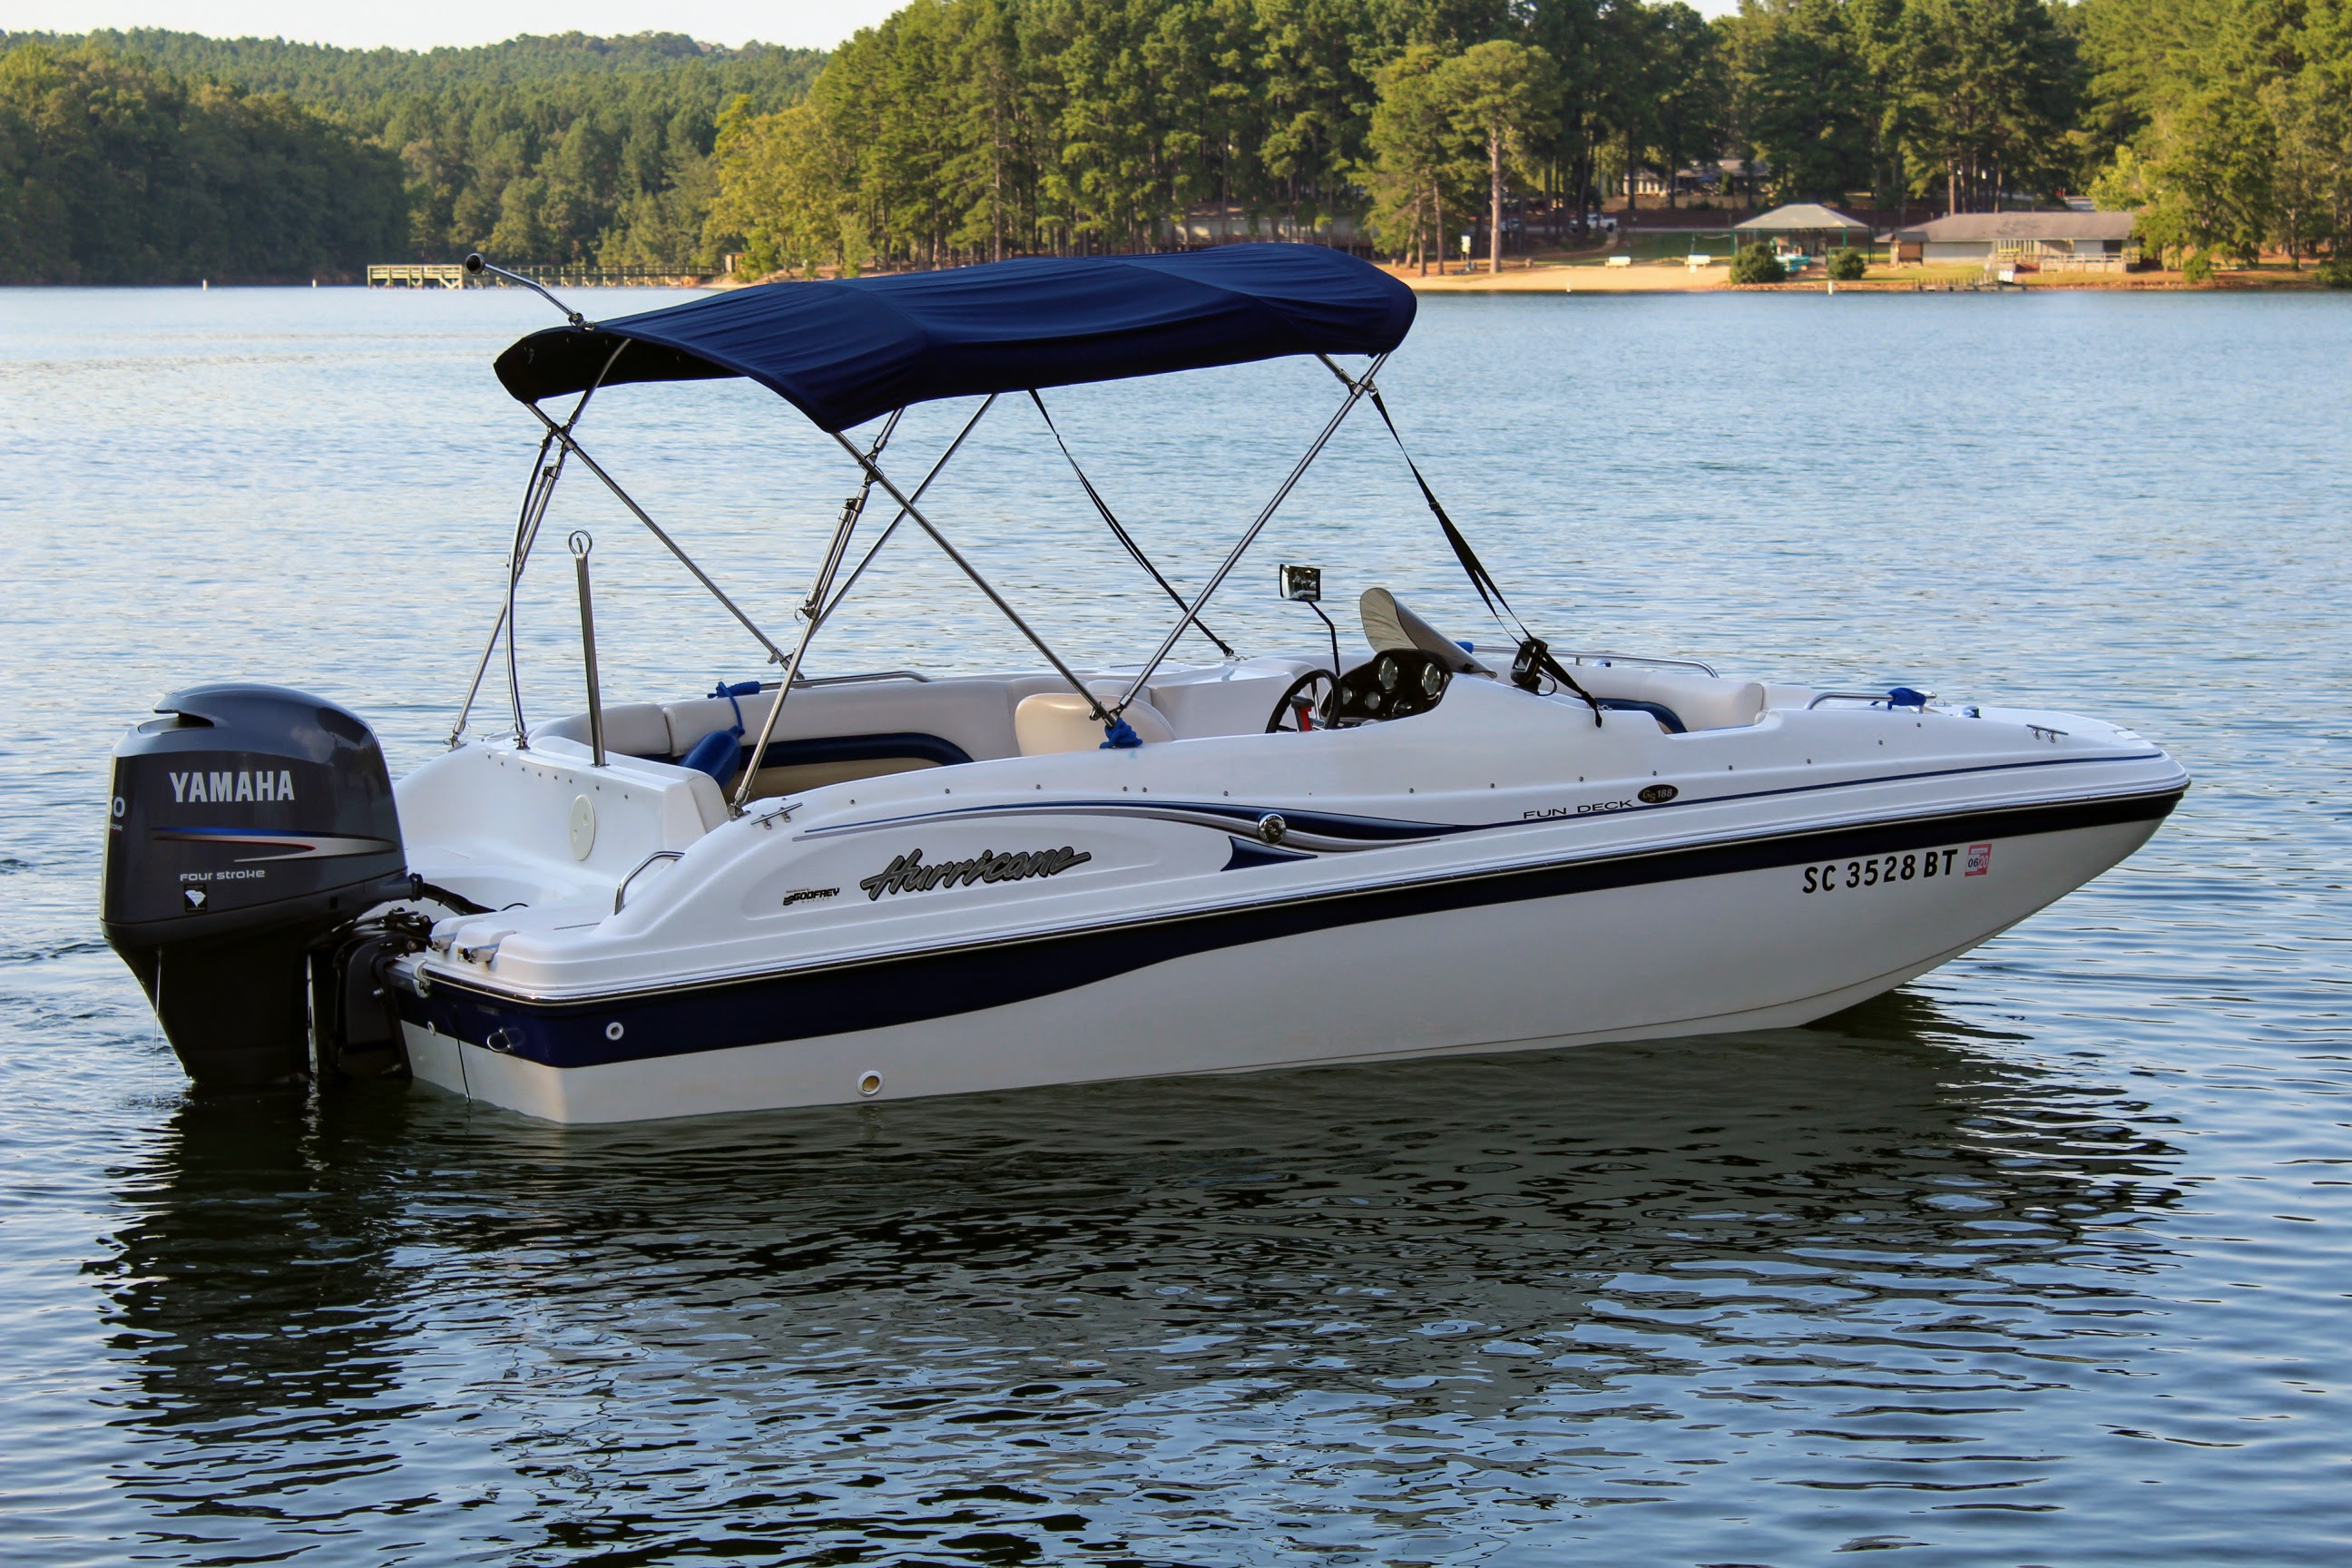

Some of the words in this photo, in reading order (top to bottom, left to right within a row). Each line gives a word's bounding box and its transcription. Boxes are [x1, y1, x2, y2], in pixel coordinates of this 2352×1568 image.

[169, 769, 296, 803] YAMAHA
[1657, 788, 1672, 798] 188
[1523, 807, 1567, 819] FUN
[1577, 799, 1632, 813] DECK
[860, 846, 1092, 901] Hurricane
[1802, 865, 1837, 894] SC
[1846, 855, 1916, 888] 3528
[1924, 848, 1958, 878] BT
[793, 887, 840, 900] GODFREY
